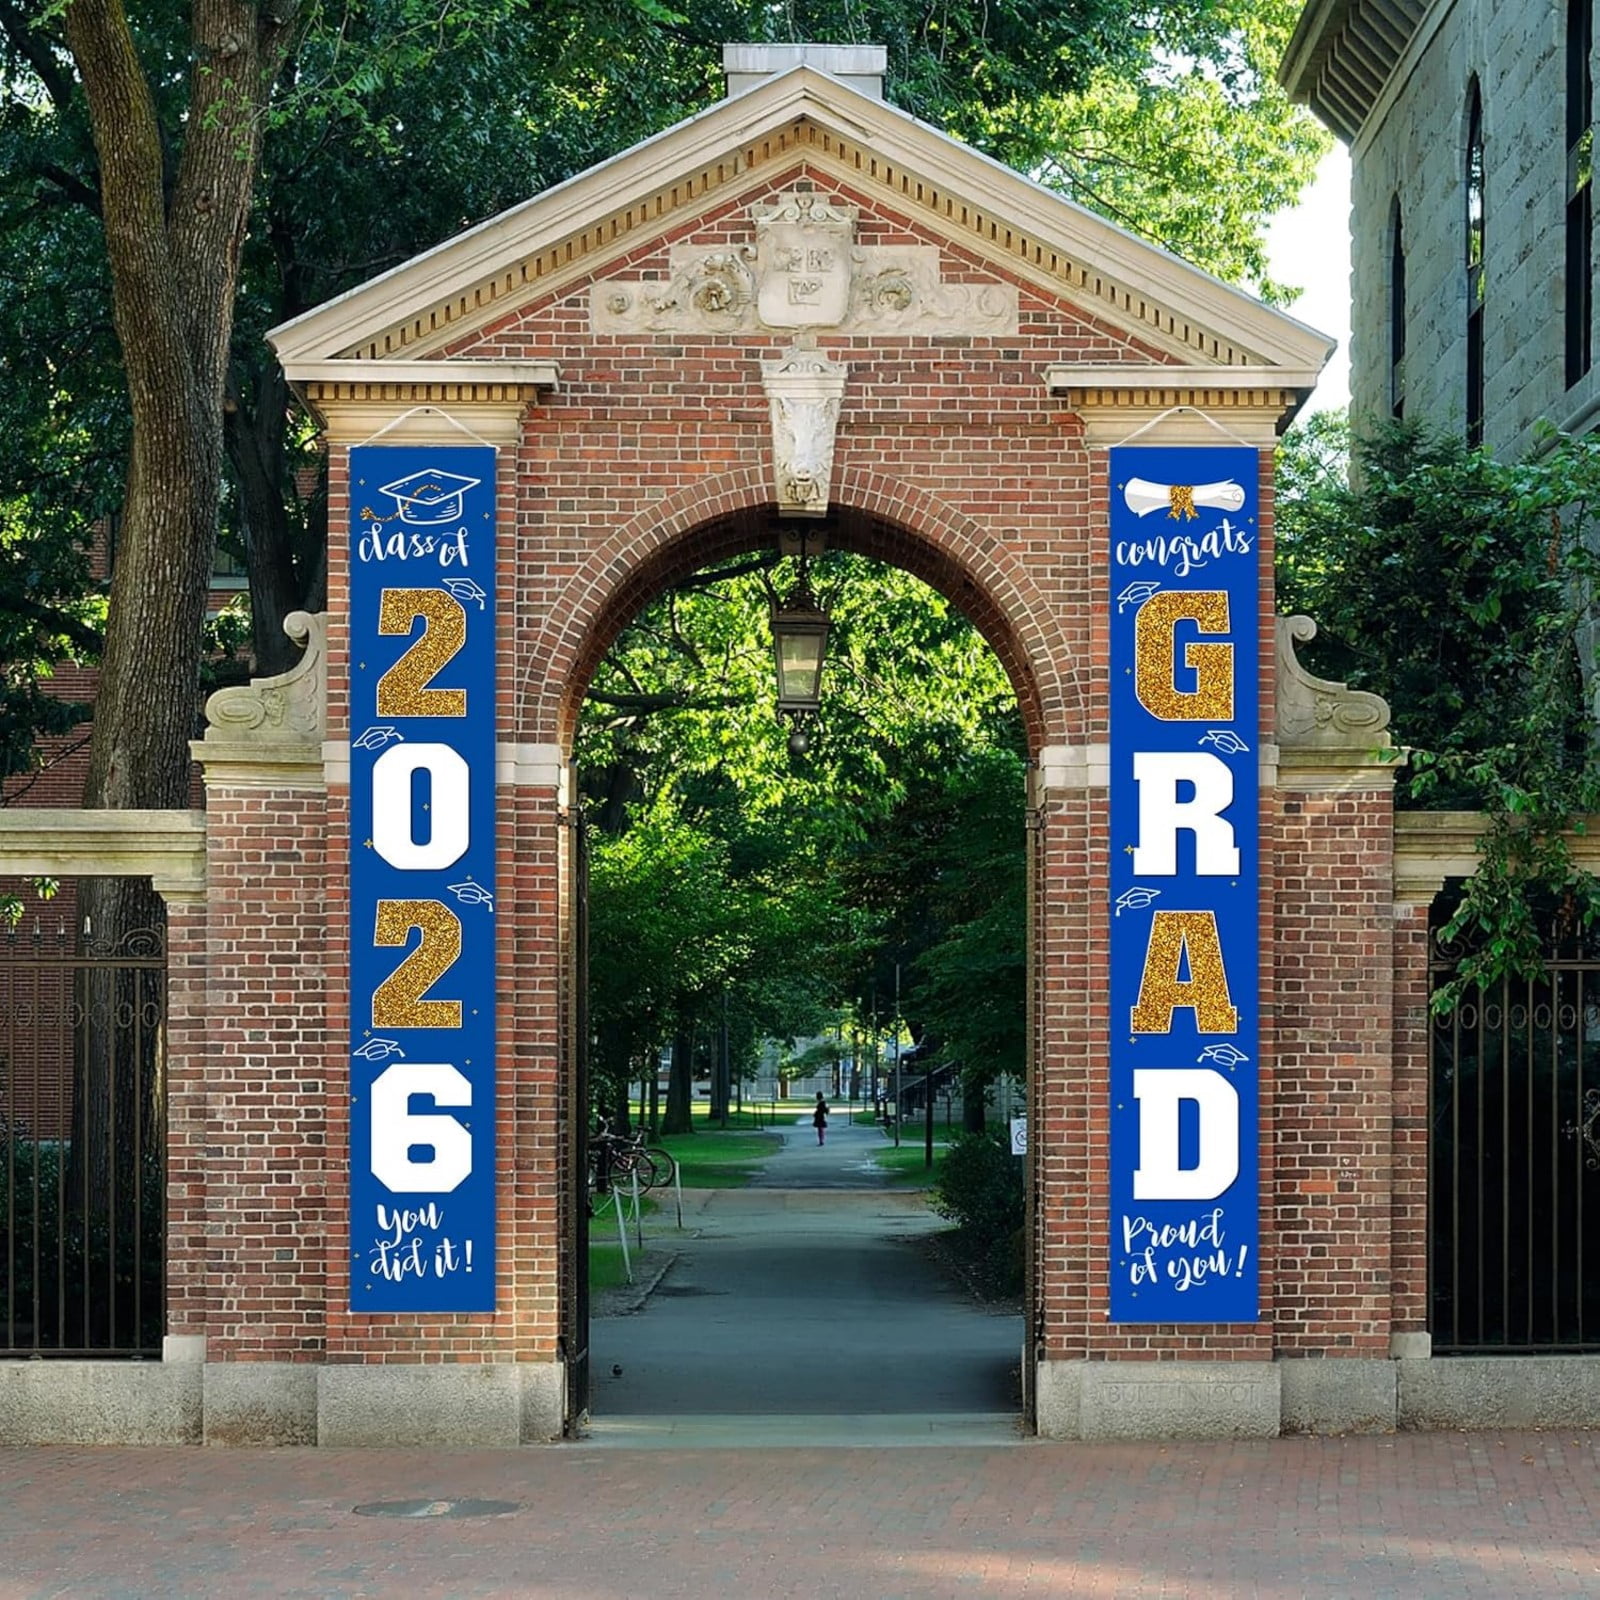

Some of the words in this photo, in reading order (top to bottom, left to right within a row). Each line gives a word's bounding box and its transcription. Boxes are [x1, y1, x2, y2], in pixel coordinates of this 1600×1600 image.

[359, 523, 441, 563] class
[438, 527, 470, 567] of
[1116, 518, 1255, 577] congrats
[374, 1202, 444, 1249] you
[369, 1237, 428, 1282] did
[1130, 1246, 1158, 1285] of
